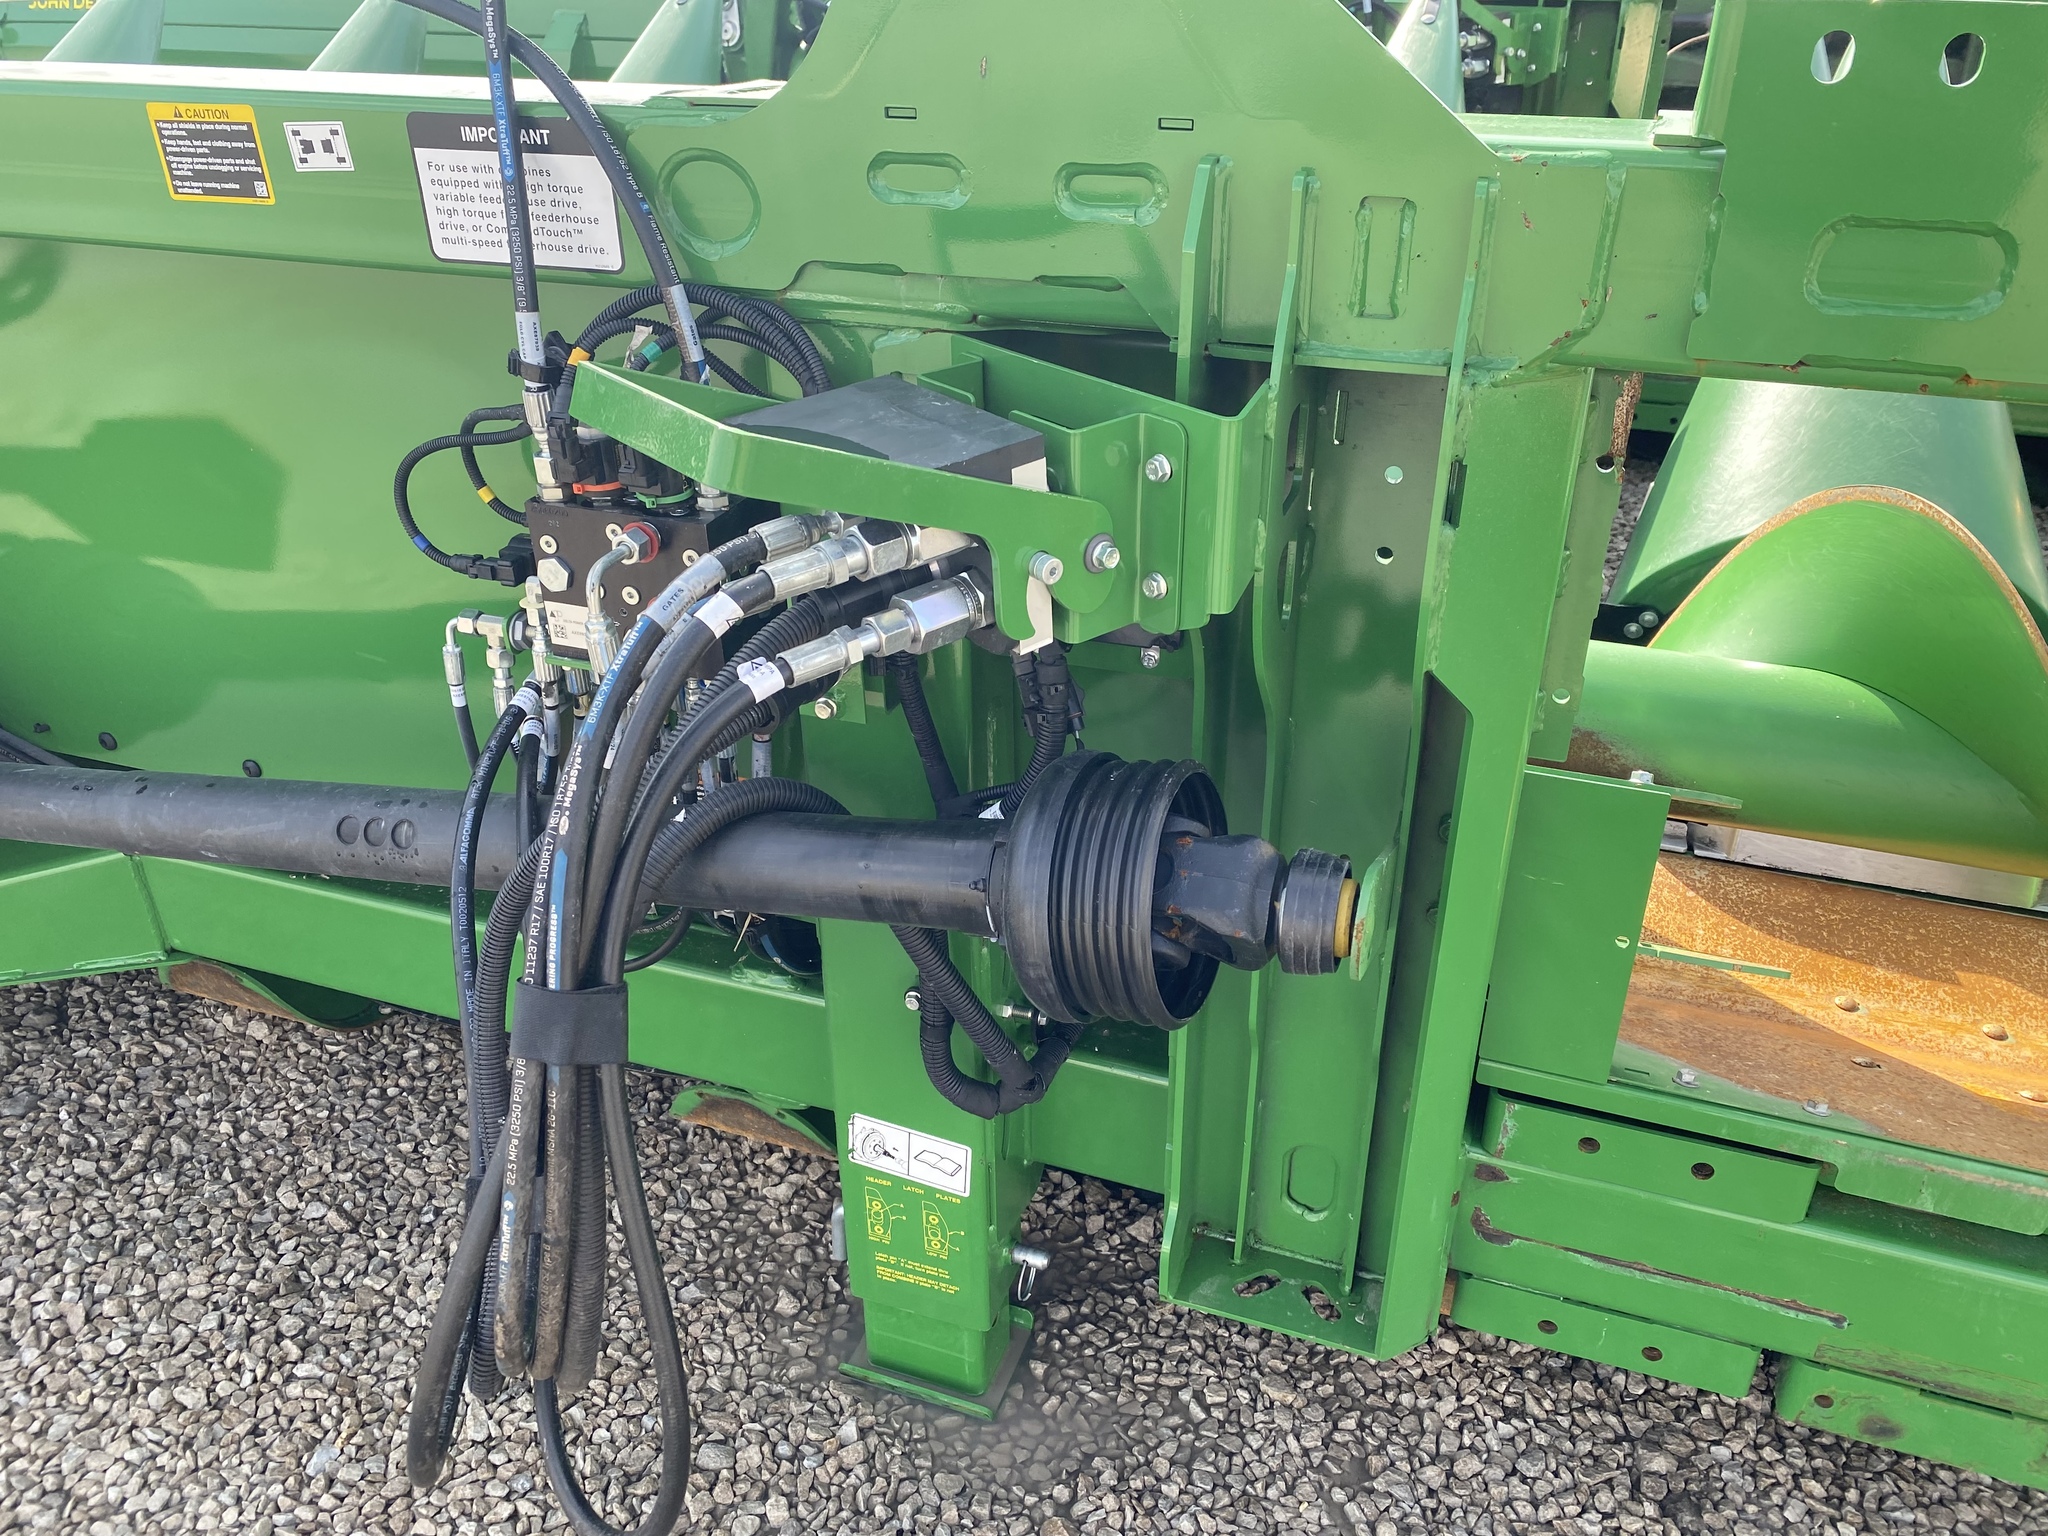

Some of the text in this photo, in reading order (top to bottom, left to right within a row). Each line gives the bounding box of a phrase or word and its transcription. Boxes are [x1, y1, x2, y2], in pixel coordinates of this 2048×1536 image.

[185, 109, 229, 119] CAUTION
[460, 126, 550, 145] IMPOANT
[427, 161, 445, 172] For
[449, 164, 468, 173] use
[471, 164, 495, 175] with
[430, 177, 480, 190] equipped
[548, 184, 584, 196] torque
[433, 191, 476, 203] variable
[550, 198, 582, 211] drive,
[435, 205, 459, 219] high
[462, 208, 497, 221] torque
[531, 211, 600, 225] feederhouse
[509, 206, 518, 225] MPa
[438, 221, 469, 233] drive,
[471, 224, 483, 233] or
[441, 236, 503, 249] multi-speed
[577, 244, 610, 256] drive.
[648, 215, 680, 284] Flame Resistant
[662, 587, 685, 612] GATES
[550, 810, 561, 828] ISO
[460, 806, 477, 865] ALFAGOMMA
[539, 839, 554, 879] 100R17
[535, 882, 547, 903] SAE
[530, 913, 541, 936] R17
[513, 1079, 526, 1102] PSI)
[510, 1103, 522, 1137] (3250
[508, 1140, 519, 1161] MPa
[506, 1163, 516, 1186] 22.5
[866, 1176, 961, 1204] HEADER LATCH PLATES
